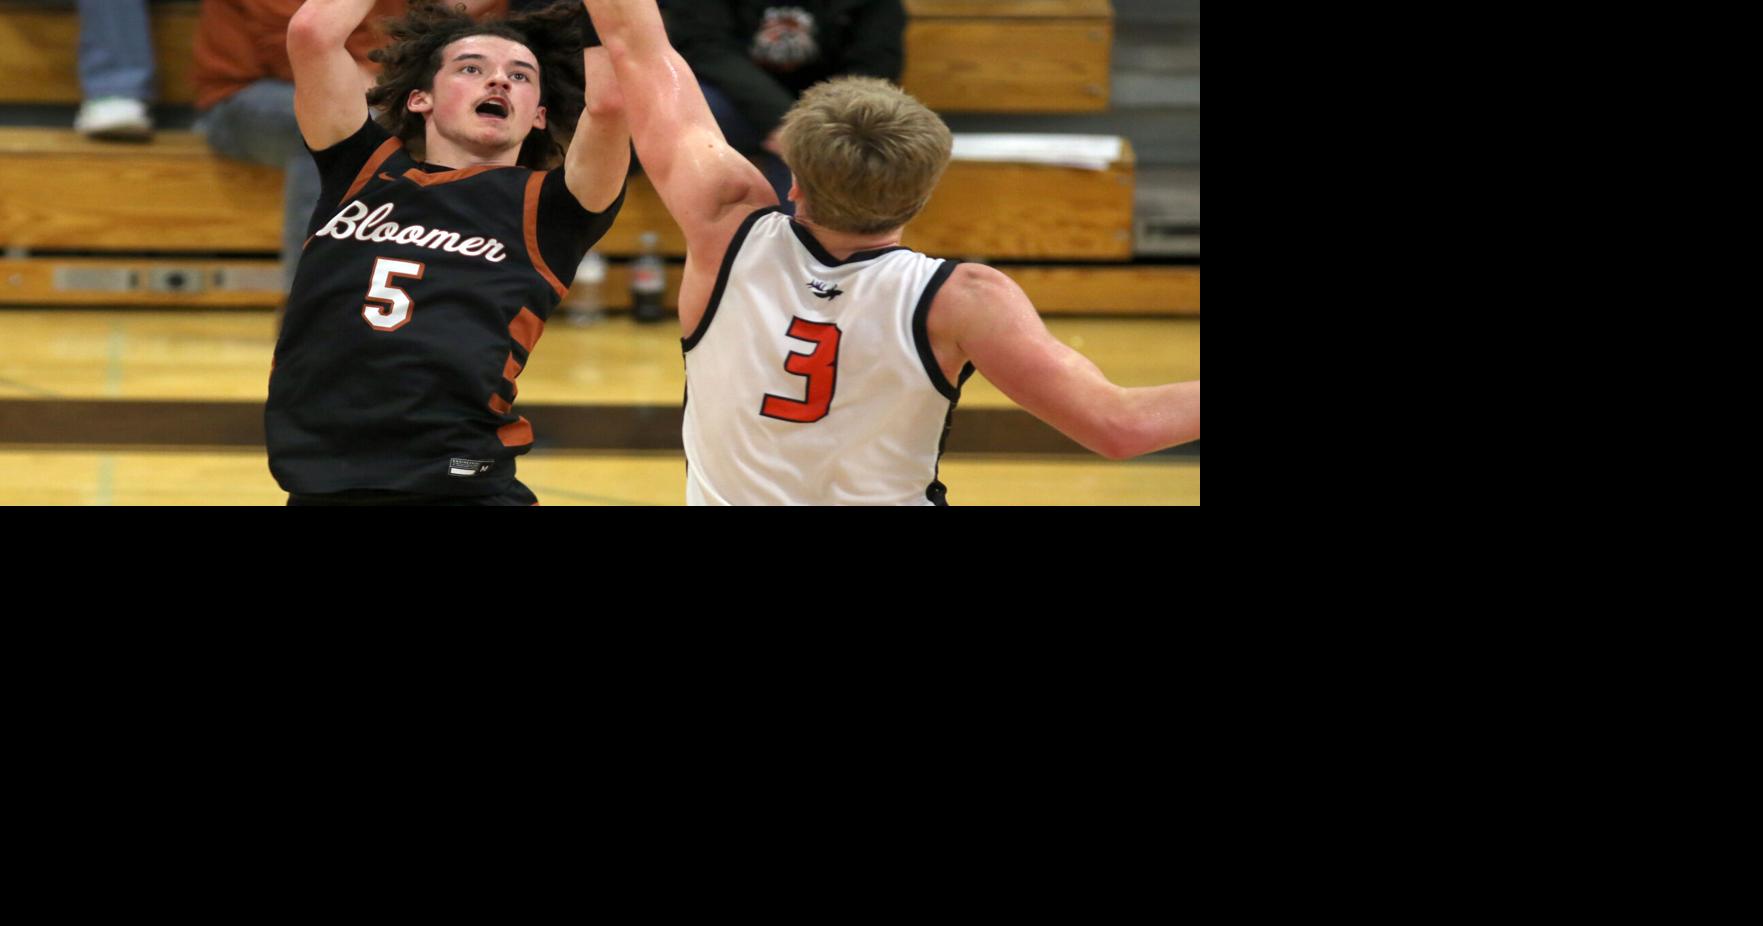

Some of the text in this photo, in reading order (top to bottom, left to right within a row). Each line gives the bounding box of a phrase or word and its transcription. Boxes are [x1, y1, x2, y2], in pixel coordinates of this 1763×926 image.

[315, 200, 506, 263] Bloomer
[361, 256, 425, 332] 5
[759, 315, 842, 423] 3
